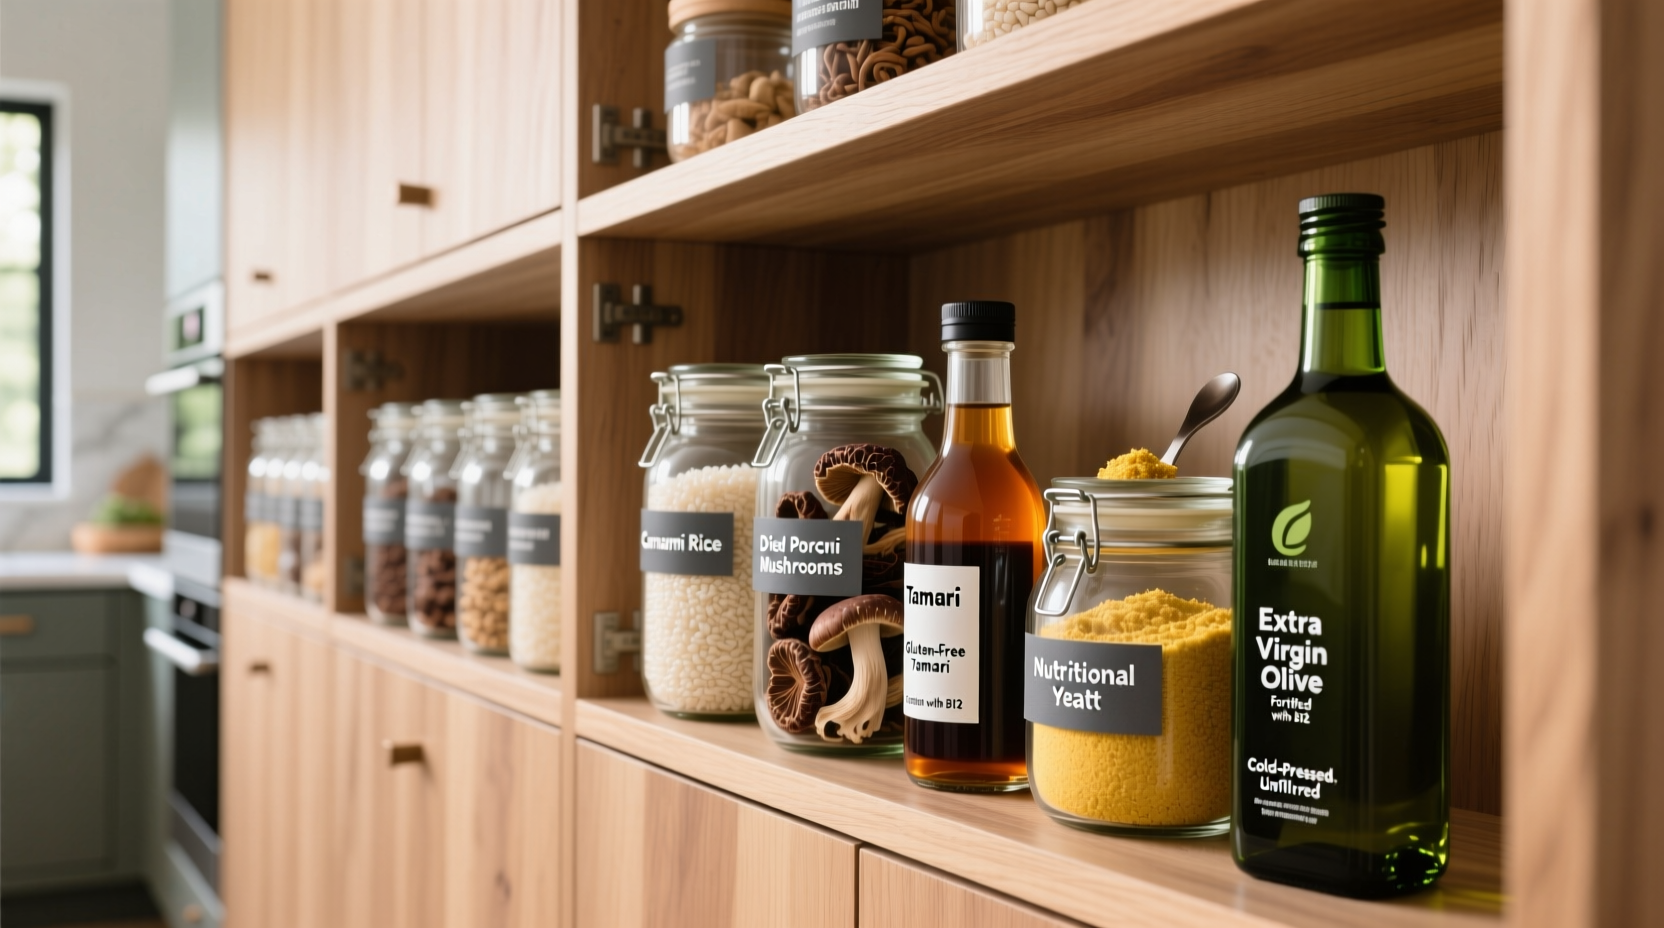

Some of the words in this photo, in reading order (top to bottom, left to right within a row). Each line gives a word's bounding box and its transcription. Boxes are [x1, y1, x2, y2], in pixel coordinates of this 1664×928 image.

[688, 533, 722, 552] Rice
[906, 586, 961, 607] Tamari
[1259, 606, 1322, 635] Extra
[905, 641, 966, 657] Gluten-Free
[1255, 636, 1328, 670] Virgin
[911, 658, 950, 673] Tamari
[1034, 656, 1135, 686] Nutritional
[1260, 664, 1324, 694] Olive
